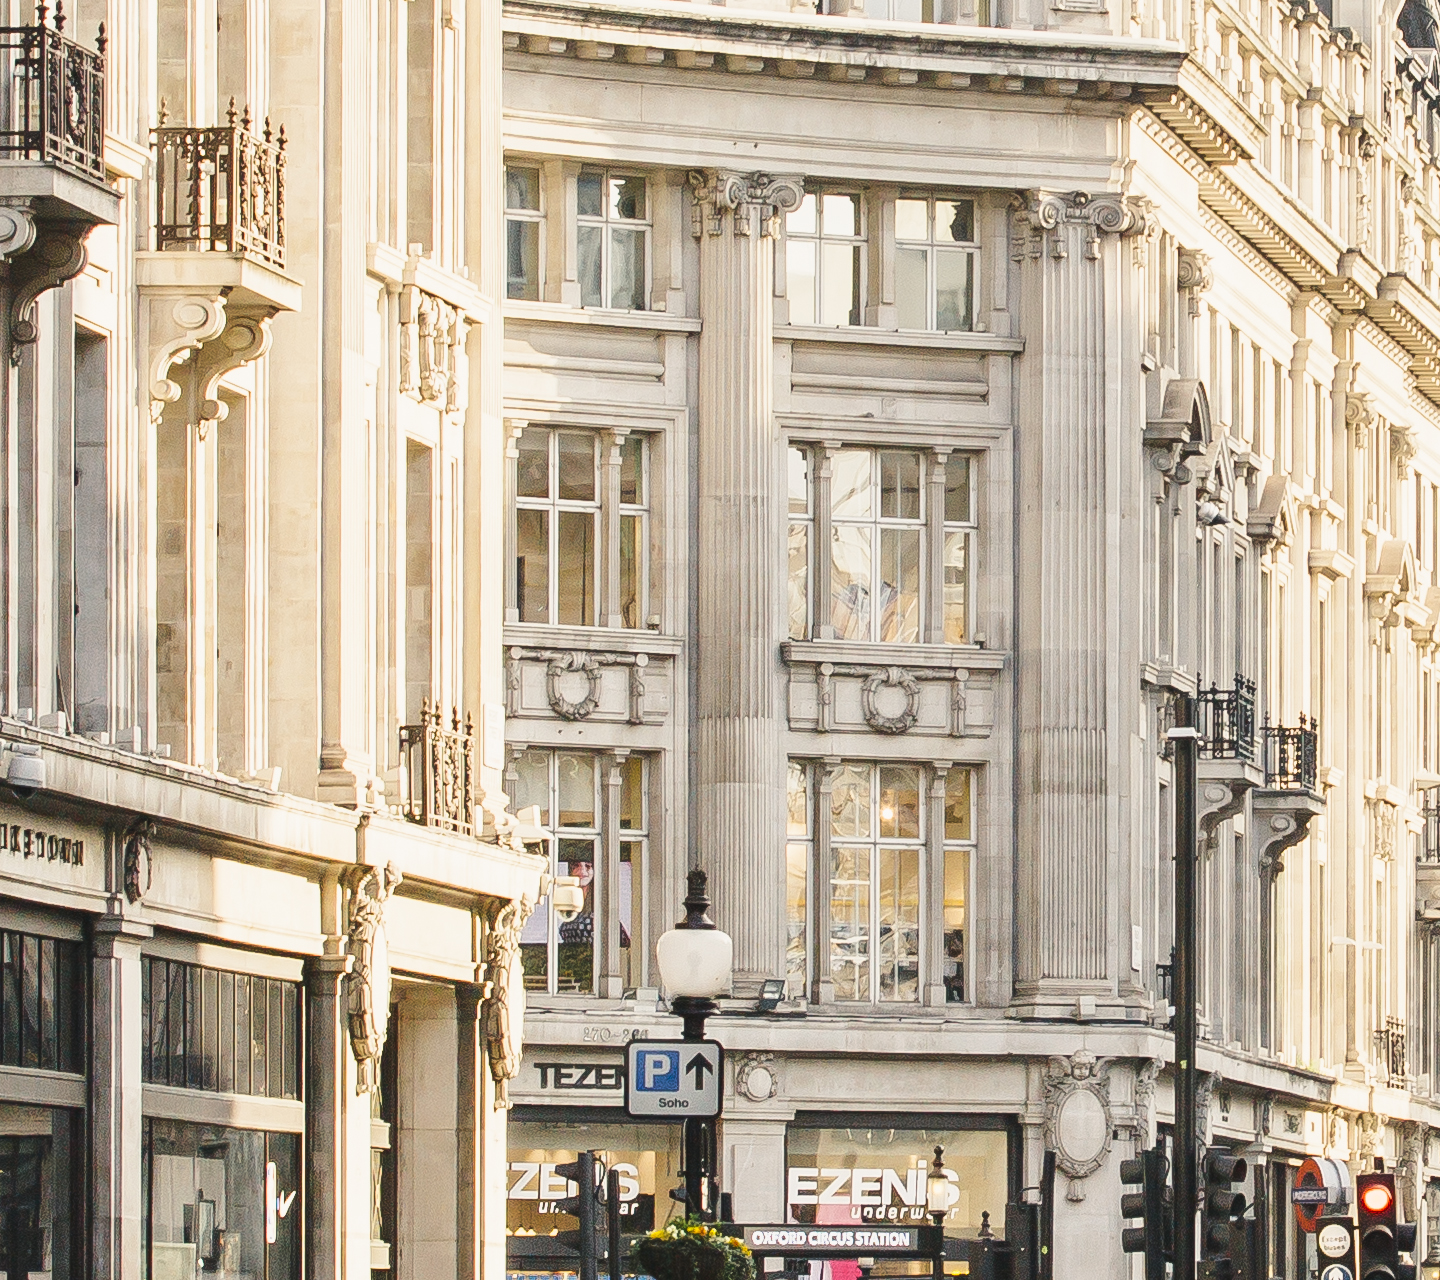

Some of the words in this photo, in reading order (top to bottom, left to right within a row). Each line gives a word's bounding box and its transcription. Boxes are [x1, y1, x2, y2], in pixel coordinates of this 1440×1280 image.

[533, 1062, 625, 1090] TEZE
[644, 1053, 671, 1089] P
[658, 1097, 690, 1109] Soho
[850, 1205, 960, 1220] underwr
[751, 1230, 806, 1247] OXFORD
[808, 1230, 854, 1247] CIRCUS
[855, 1231, 910, 1247] STATION
